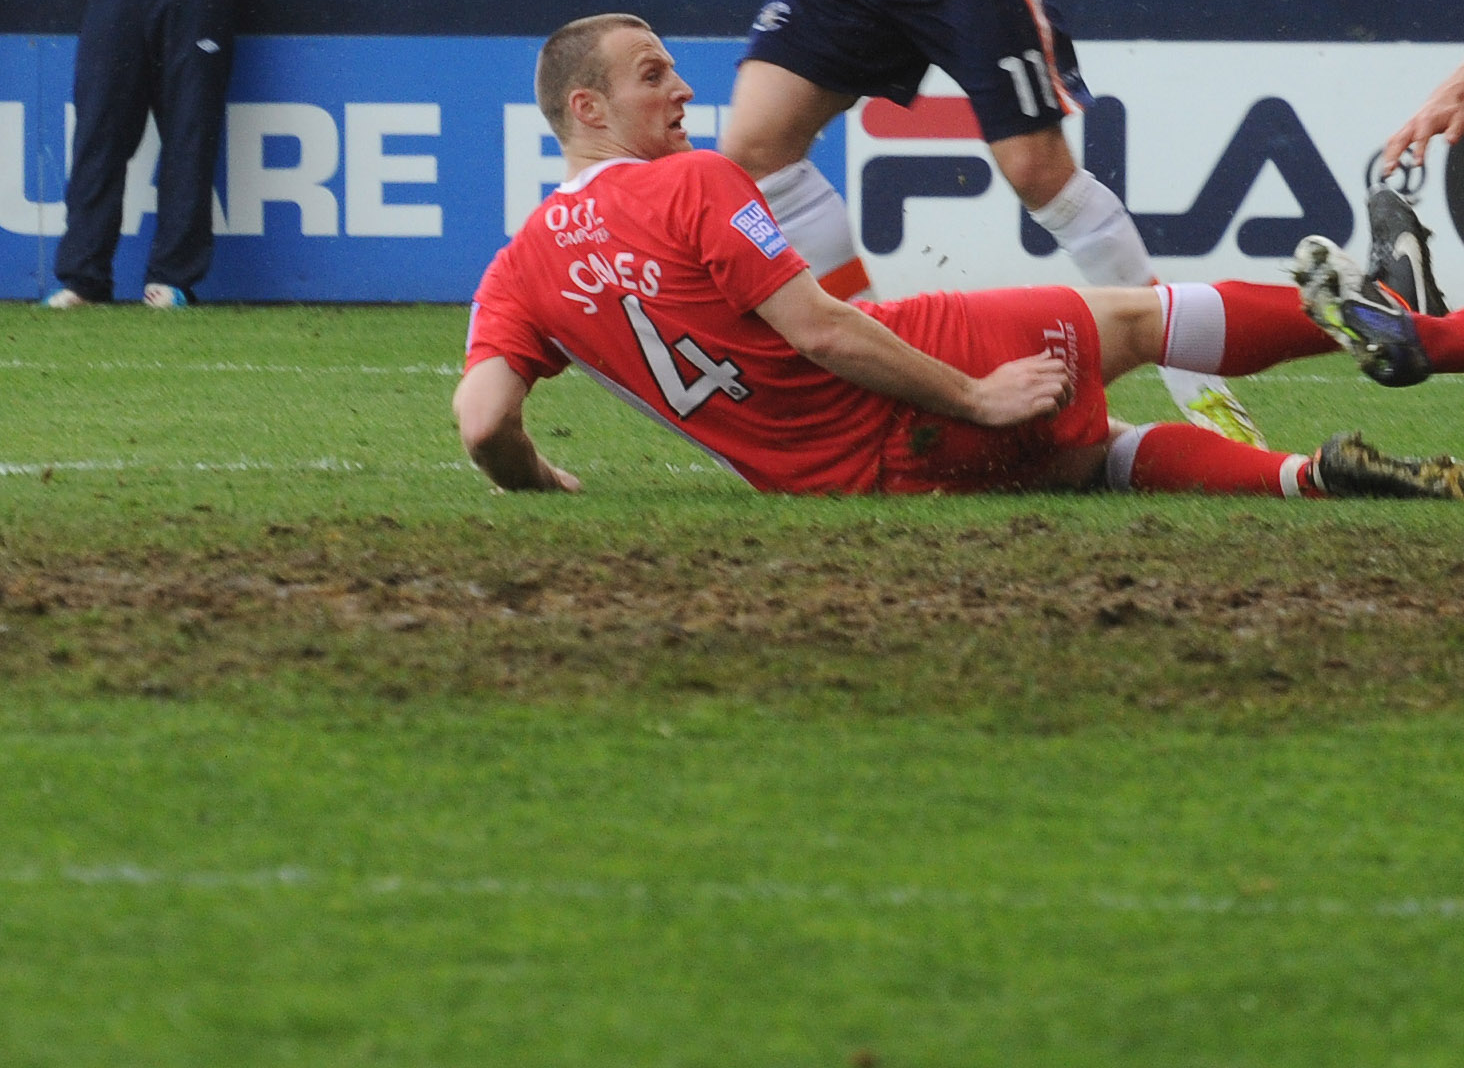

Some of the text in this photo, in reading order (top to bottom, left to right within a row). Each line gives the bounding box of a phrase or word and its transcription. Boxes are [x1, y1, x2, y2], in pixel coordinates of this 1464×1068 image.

[997, 48, 1060, 119] 11
[748, 220, 775, 244] SQ
[560, 251, 662, 315] JONES
[619, 293, 753, 420] 4
